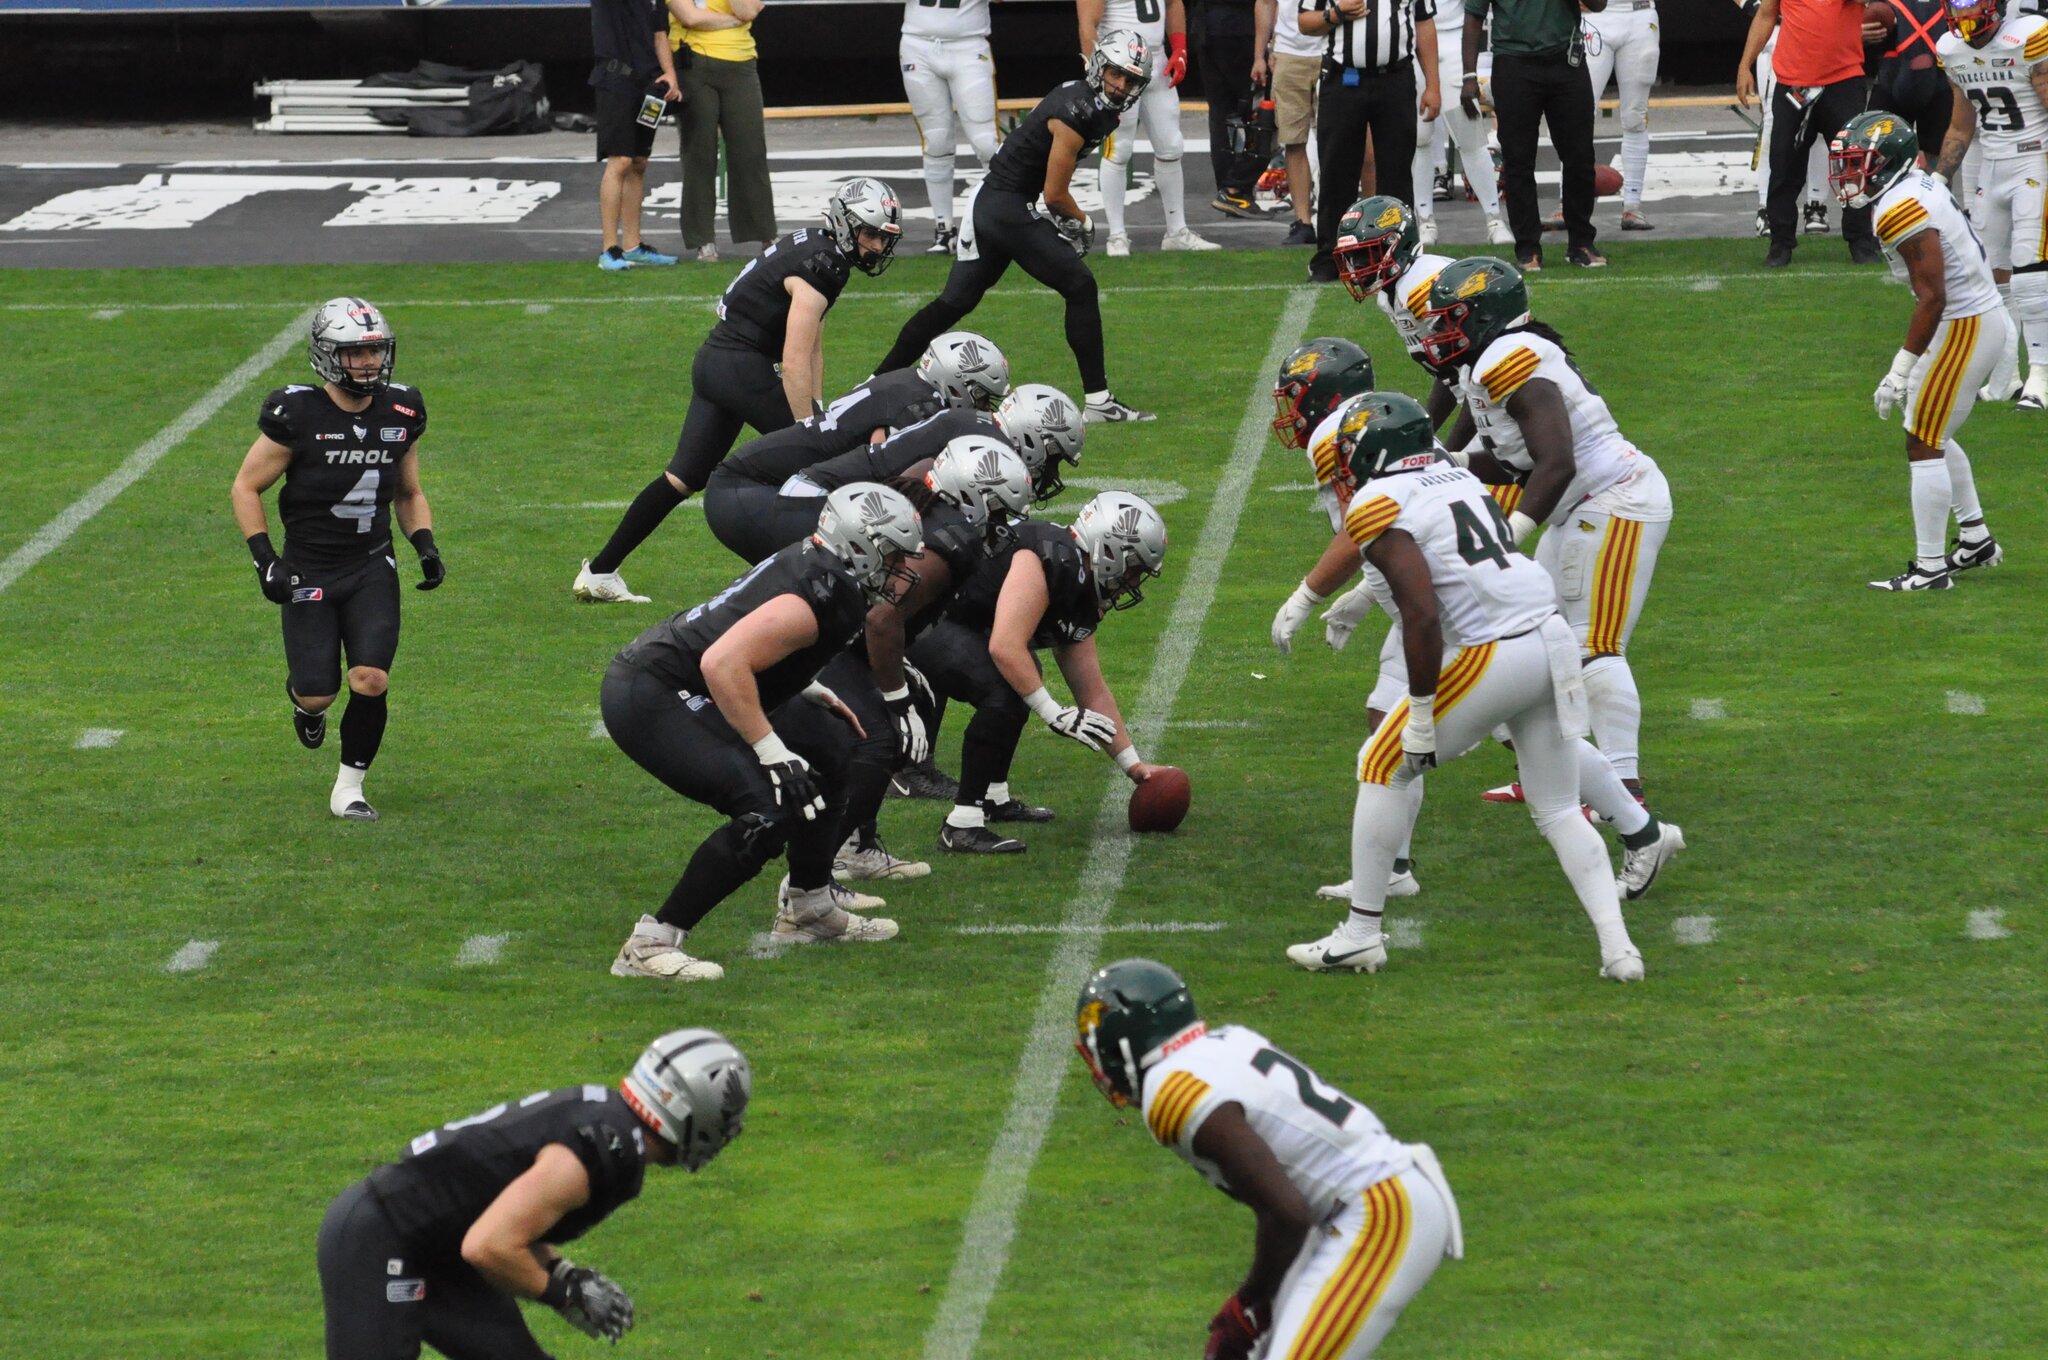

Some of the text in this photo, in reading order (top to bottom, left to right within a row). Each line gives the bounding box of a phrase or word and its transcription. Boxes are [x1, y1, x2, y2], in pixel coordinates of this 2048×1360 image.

[1966, 86, 2025, 131] 23
[325, 450, 394, 464] TIROL
[1401, 455, 1432, 469] FORE
[1416, 470, 1470, 487] JACKSON
[330, 469, 381, 533] 4
[1448, 494, 1521, 571] 44
[1250, 1048, 1355, 1130] 2
